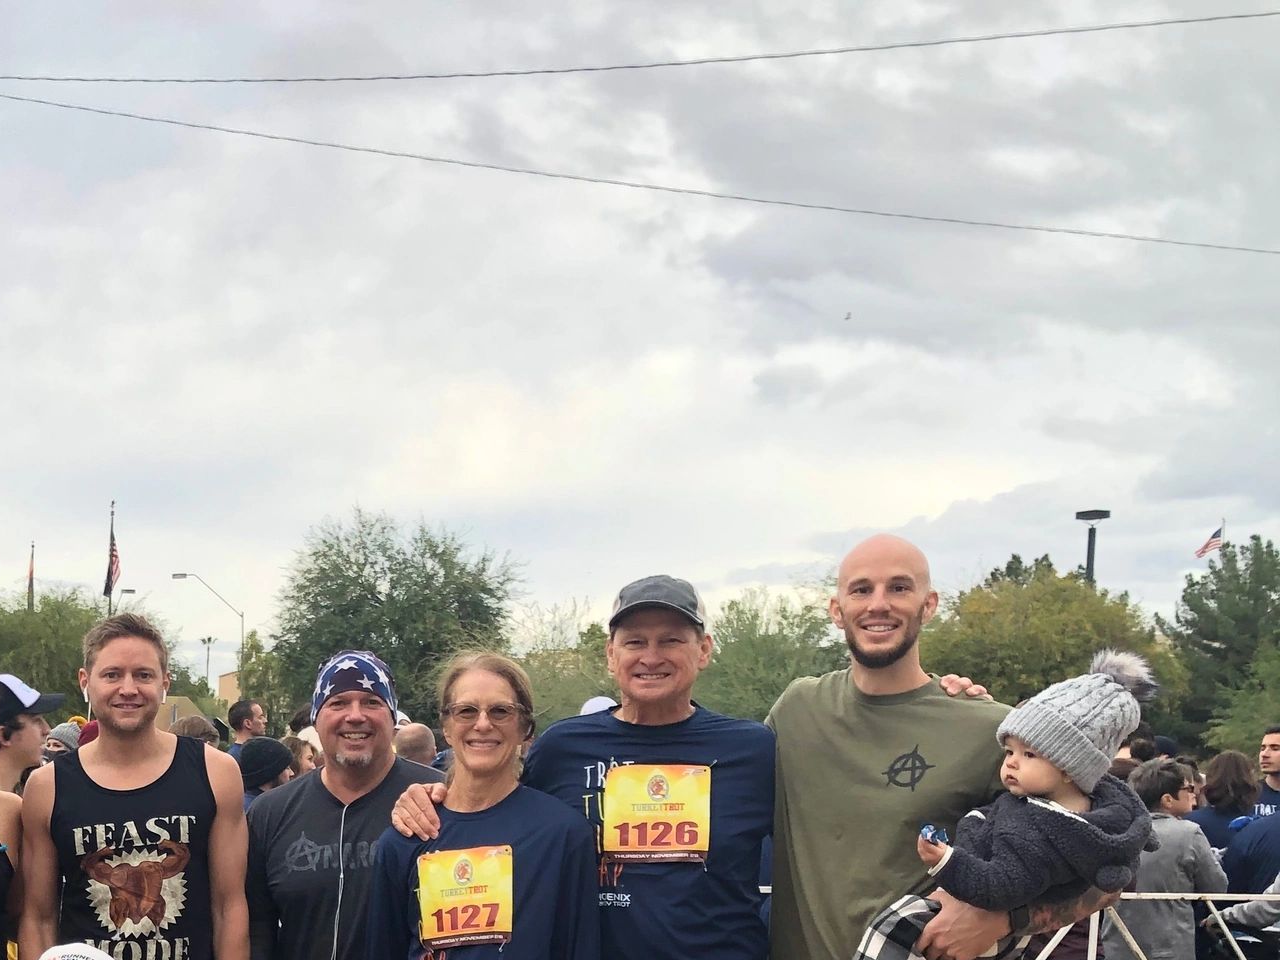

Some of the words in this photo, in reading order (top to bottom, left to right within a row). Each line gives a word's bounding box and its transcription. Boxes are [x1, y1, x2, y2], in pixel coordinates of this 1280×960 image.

[1254, 803, 1278, 816] TROT
[72, 815, 197, 856] FEAST
[613, 821, 699, 847] 1126
[431, 903, 500, 933] 1127
